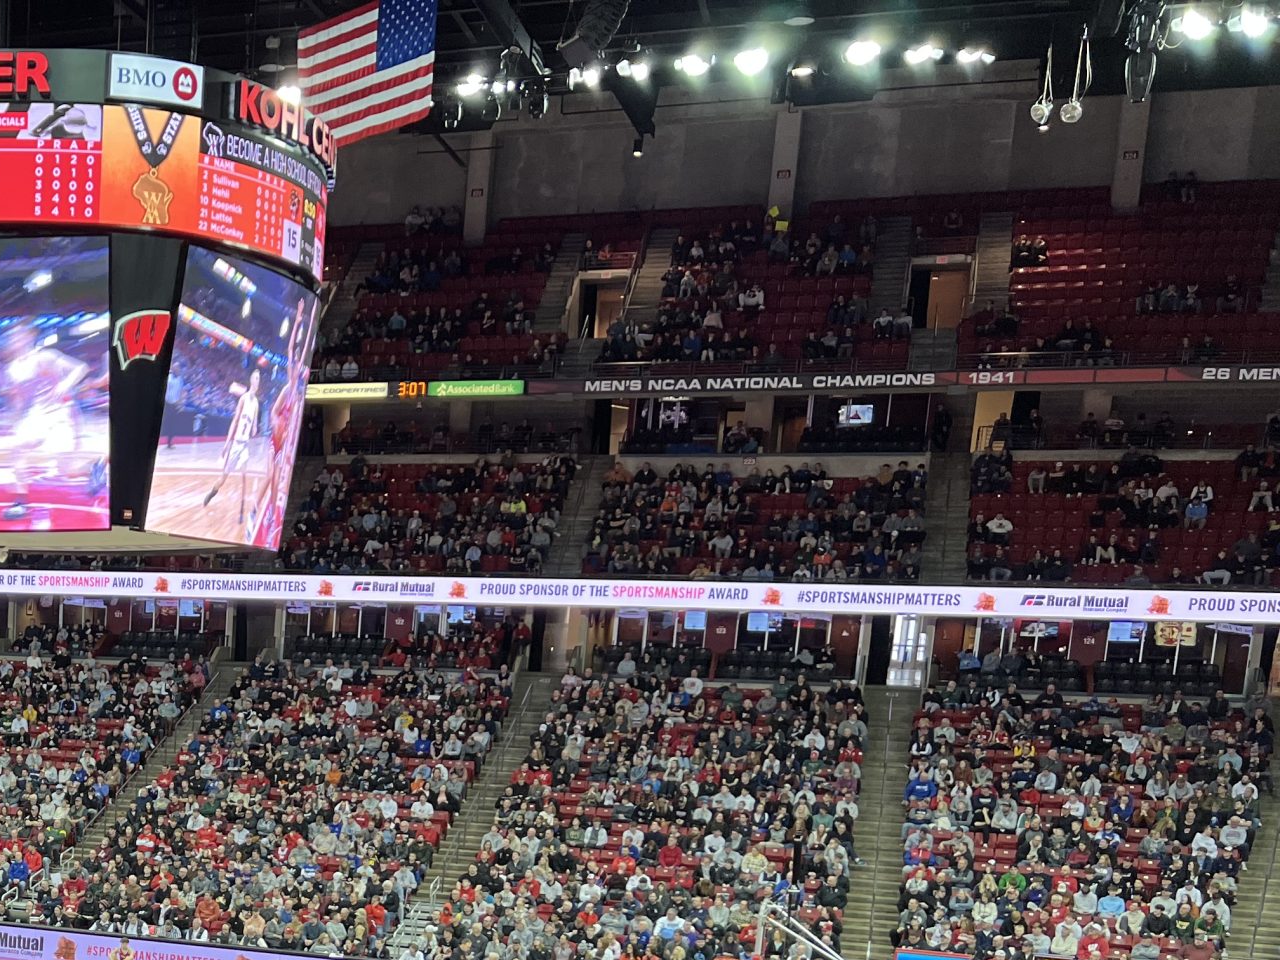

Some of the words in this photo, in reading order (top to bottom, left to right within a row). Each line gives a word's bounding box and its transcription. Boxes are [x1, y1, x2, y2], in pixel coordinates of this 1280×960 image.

[117, 67, 166, 88] BMO
[227, 134, 262, 165] BECOME
[271, 153, 287, 176] HIGH
[213, 174, 239, 188] Sullivan
[287, 228, 297, 248] 15
[968, 371, 1015, 384] 1941
[1202, 367, 1230, 380] 26
[398, 382, 426, 396] 3:07
[584, 379, 642, 391] MEN'S
[648, 378, 702, 391] NCAA
[707, 376, 803, 389] NATIONAL
[813, 373, 935, 388] CHAMPIONS
[7, 575, 18, 585] OF
[20, 575, 36, 586] THE
[38, 576, 110, 588] SPORTSMANSHIP
[112, 578, 144, 588] AWARD
[181, 579, 306, 592] #SPORTSMANSHIPMATTERS
[372, 581, 398, 592] Rural
[400, 582, 435, 593] Mutual
[480, 583, 516, 595] PROUD
[519, 584, 569, 596] SPONSOR
[572, 585, 586, 597] OF
[589, 585, 609, 597] THE
[612, 586, 705, 599] SPORTSMANSHIP
[708, 588, 749, 600] AWARD
[797, 590, 961, 606] #SPORTSMANSHIPMATTERS
[1047, 594, 1081, 607] Rural
[1084, 595, 1129, 608] Mutual
[1189, 598, 1235, 611] PROUD
